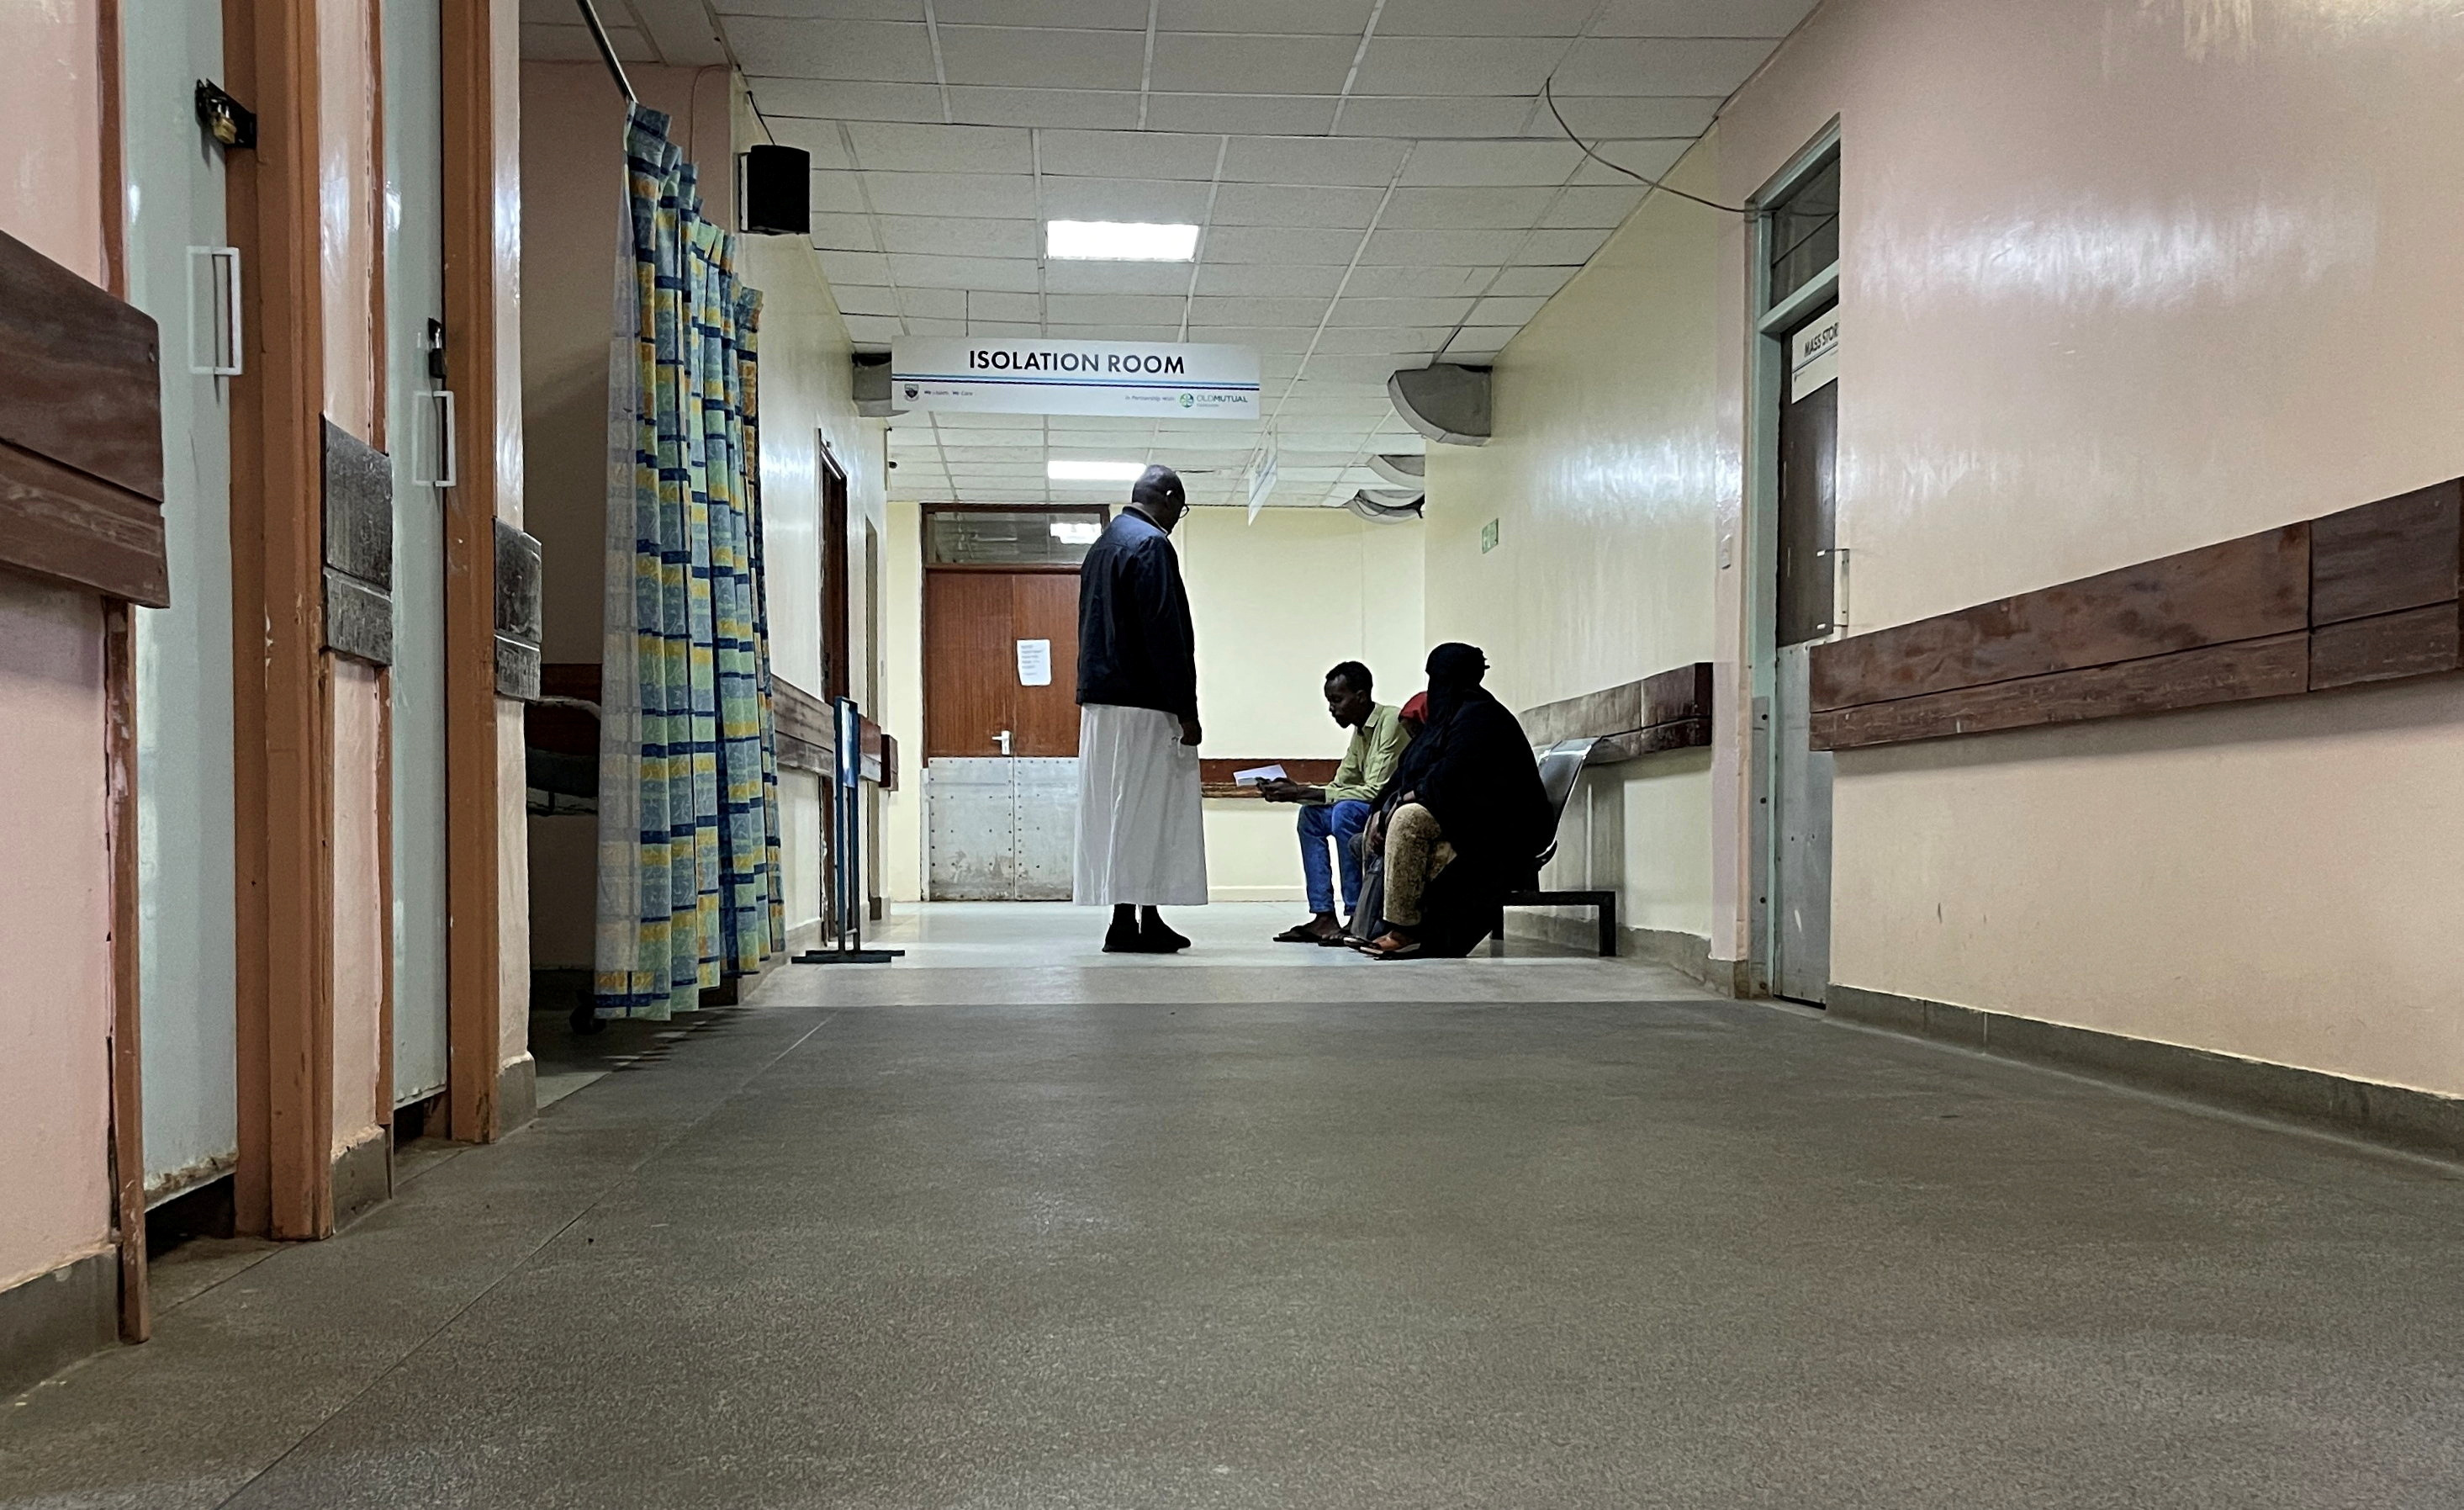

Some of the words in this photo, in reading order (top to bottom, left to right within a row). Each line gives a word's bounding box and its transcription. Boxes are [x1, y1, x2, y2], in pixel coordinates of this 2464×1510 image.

[1804, 333, 1822, 358] MASS
[970, 350, 1099, 372] ISOLATION
[1108, 354, 1185, 374] ROOM
